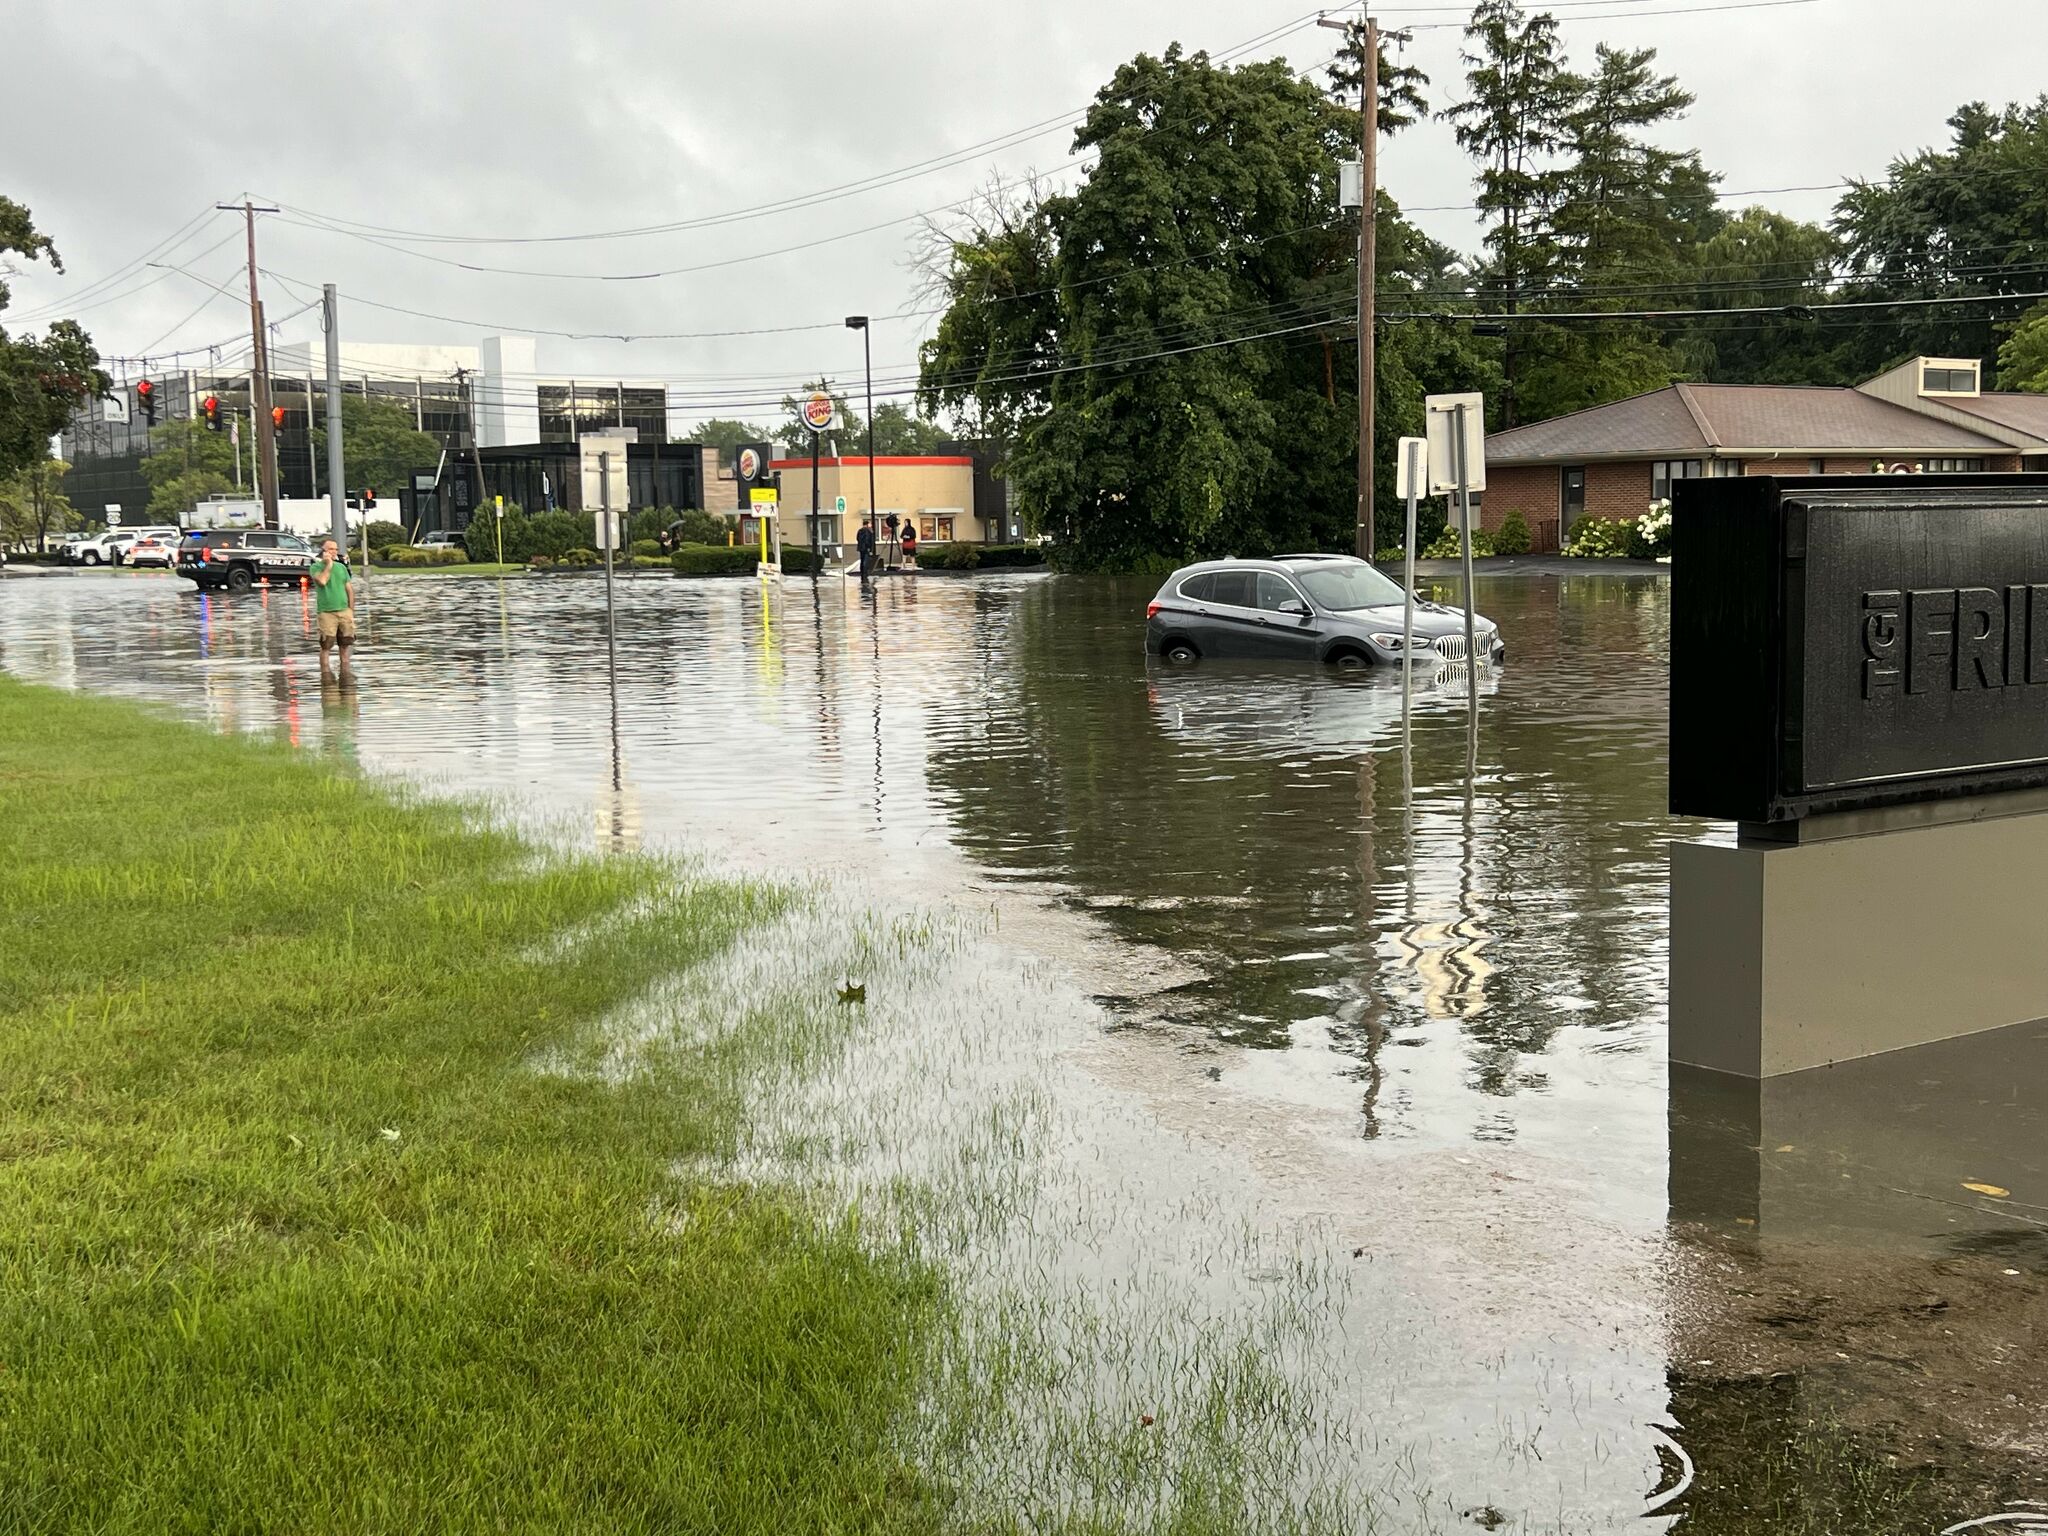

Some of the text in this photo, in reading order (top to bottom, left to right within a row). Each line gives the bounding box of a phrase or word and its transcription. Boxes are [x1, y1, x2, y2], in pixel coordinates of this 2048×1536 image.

[808, 406, 832, 419] KING
[259, 557, 302, 567] POLICE
[1860, 590, 1901, 700] TGI
